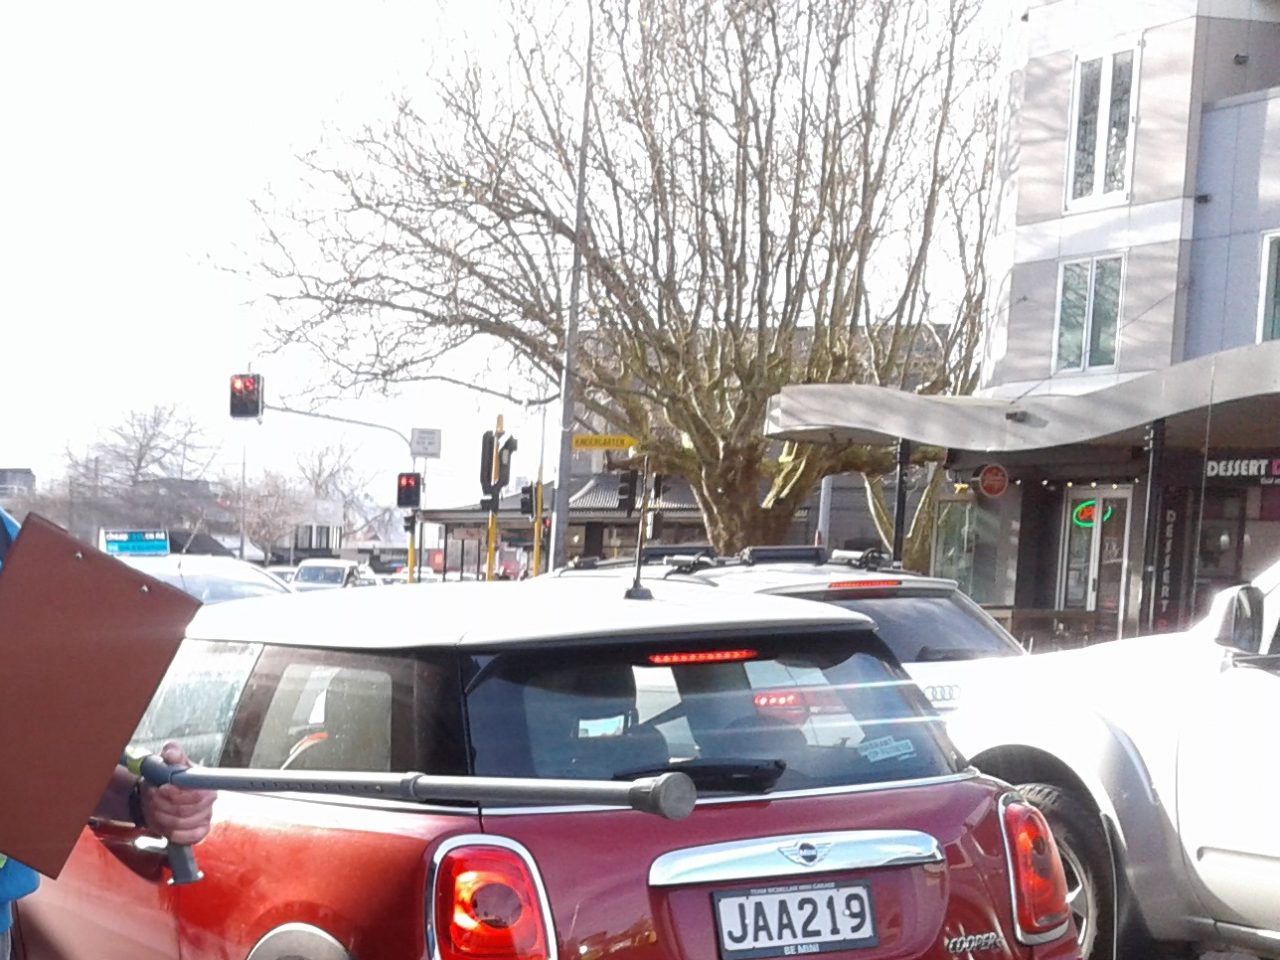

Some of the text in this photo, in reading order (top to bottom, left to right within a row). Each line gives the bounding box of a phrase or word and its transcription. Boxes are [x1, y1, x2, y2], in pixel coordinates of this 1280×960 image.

[1206, 459, 1269, 477] DESSERT
[727, 893, 867, 944] JAA219
[783, 943, 820, 956] BE MINI
[949, 932, 997, 954] COOPER
